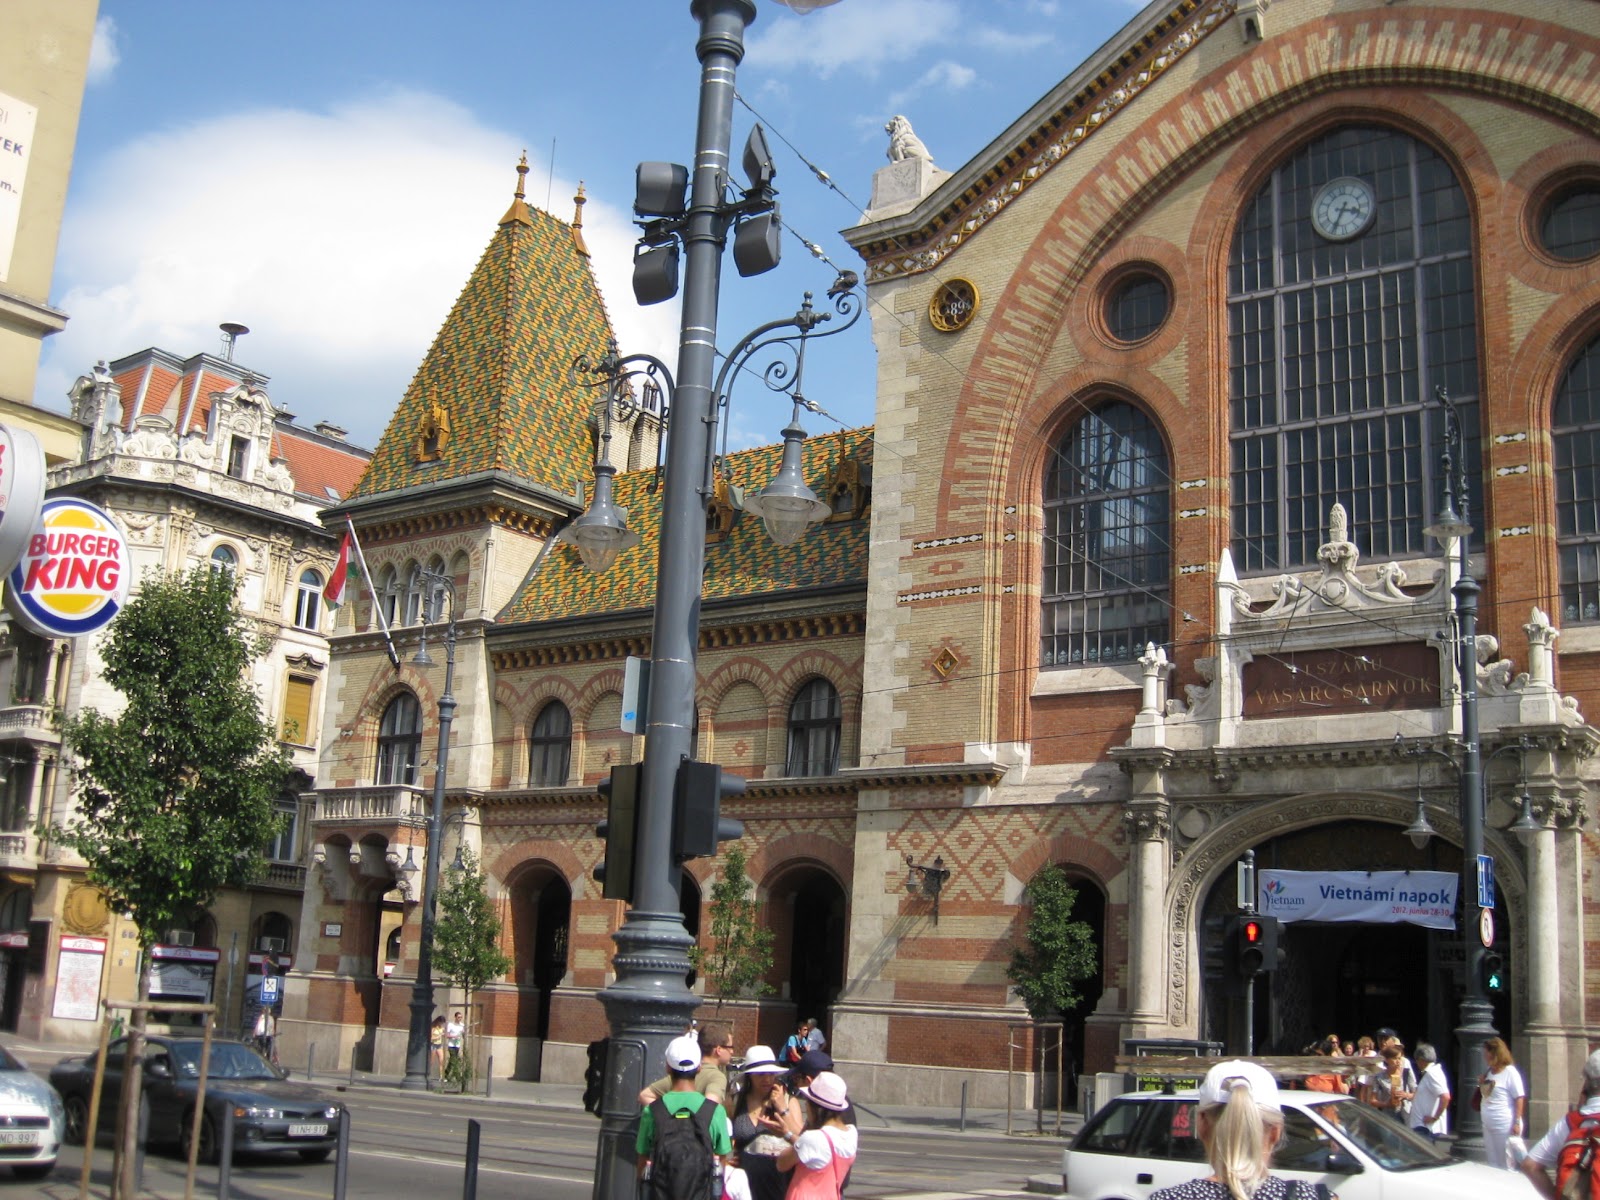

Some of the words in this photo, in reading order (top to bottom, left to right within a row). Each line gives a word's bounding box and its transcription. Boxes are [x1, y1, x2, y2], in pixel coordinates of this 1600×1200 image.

[27, 533, 120, 559] BURGER
[22, 558, 121, 593] KING
[1262, 889, 1305, 911] Vietnam
[1319, 885, 1395, 902] Vietnámi
[1398, 889, 1450, 907] napok
